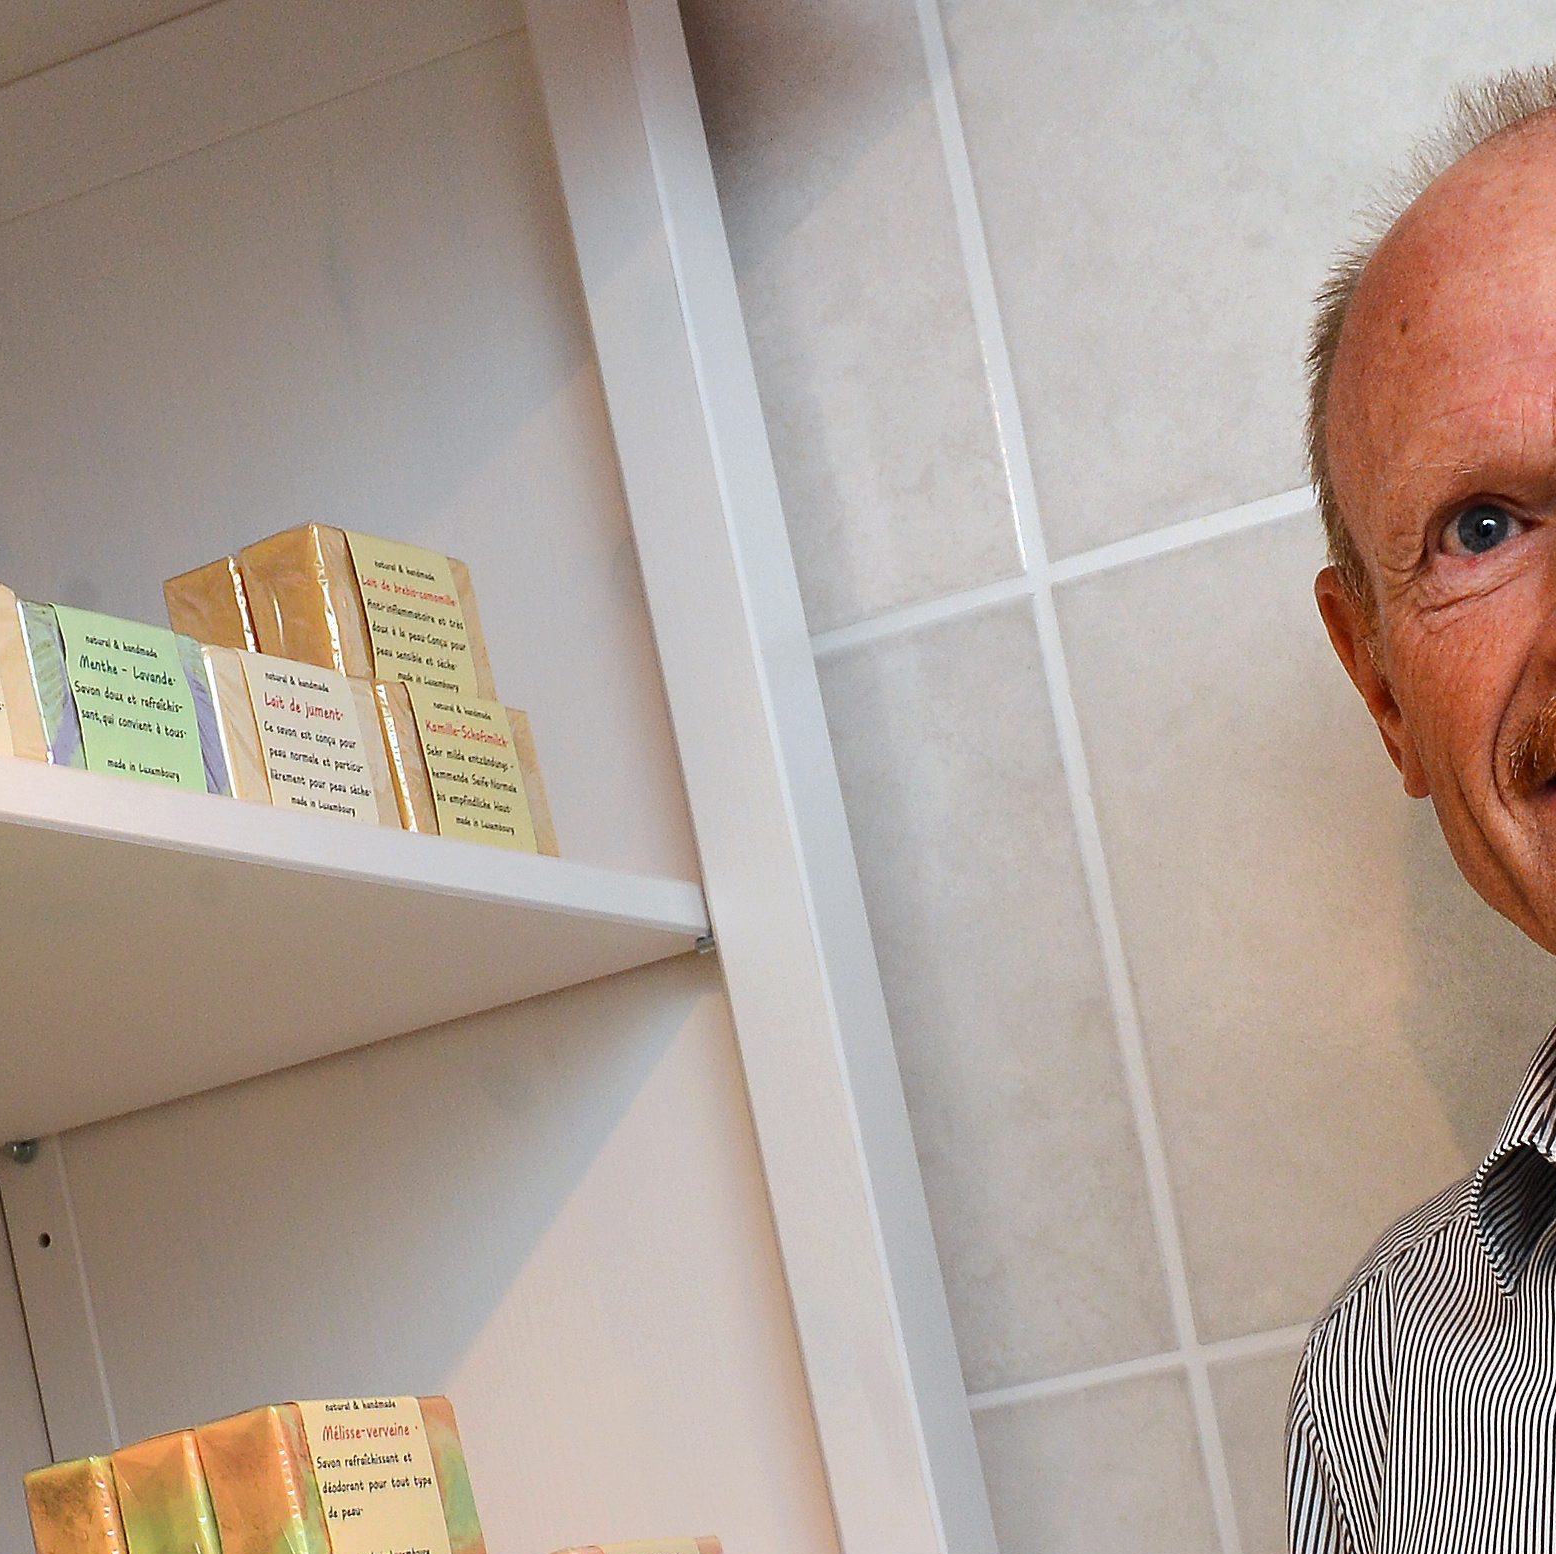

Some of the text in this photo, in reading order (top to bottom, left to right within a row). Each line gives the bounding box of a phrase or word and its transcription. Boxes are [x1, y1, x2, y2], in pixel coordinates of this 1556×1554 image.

[79, 653, 118, 675] Menthe
[316, 1452, 412, 1469] Savon rafraîchissant et
[322, 1475, 432, 1494] déodorant pour tout type
[328, 1505, 338, 1518] de
